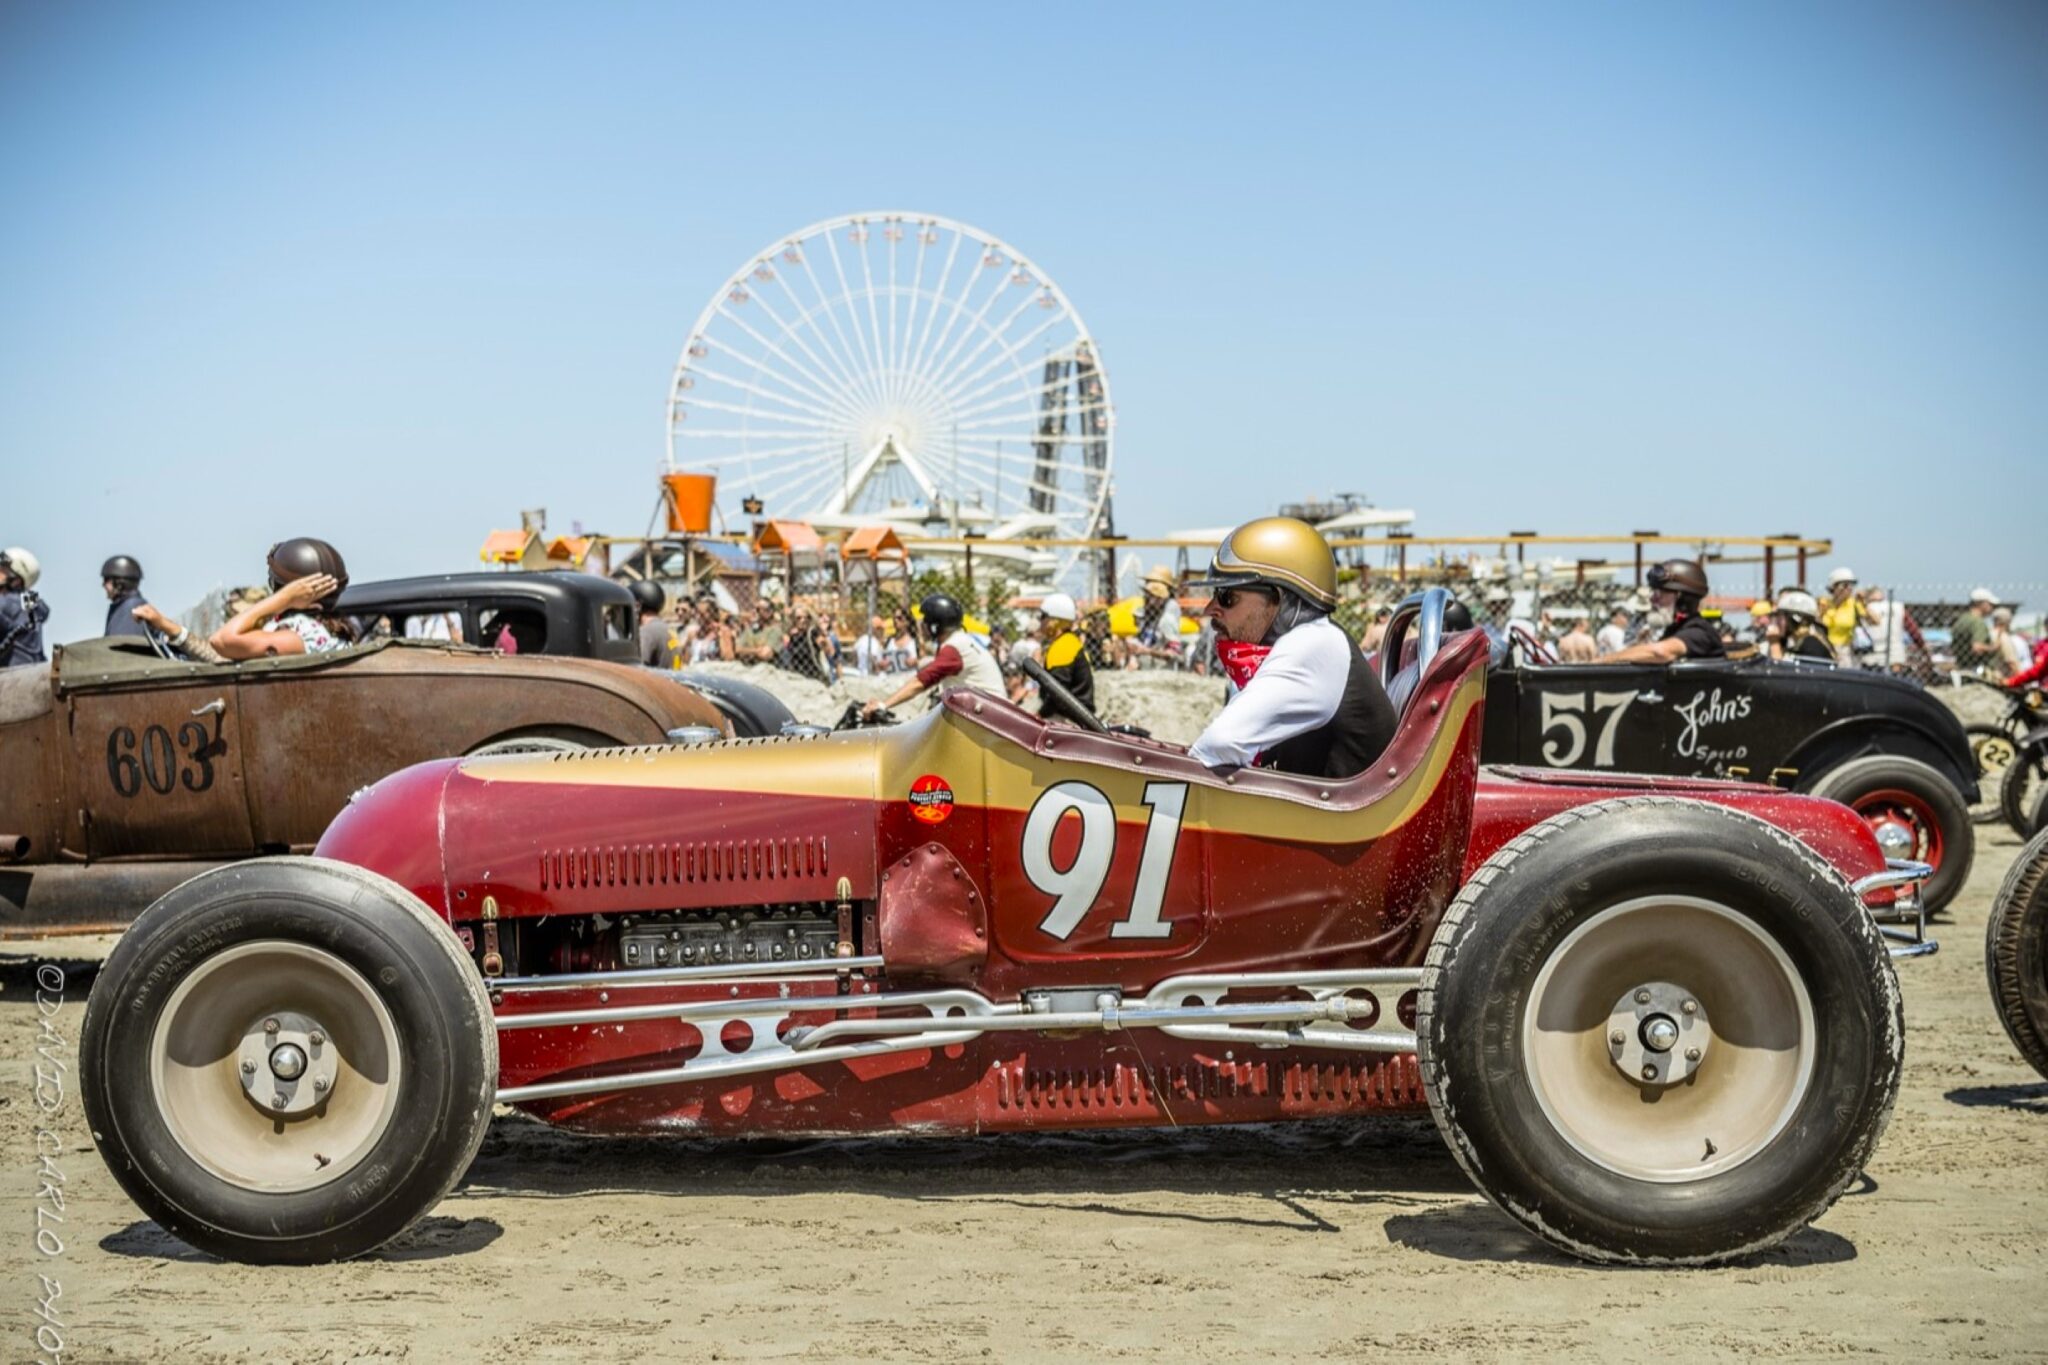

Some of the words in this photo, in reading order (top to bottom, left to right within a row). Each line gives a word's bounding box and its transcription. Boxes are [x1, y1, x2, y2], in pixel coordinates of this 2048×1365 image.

[107, 721, 214, 798] 603
[1541, 689, 1639, 767] 57
[1673, 687, 1752, 757] John's
[1984, 744, 2010, 767] 22
[1021, 780, 1190, 940] 91
